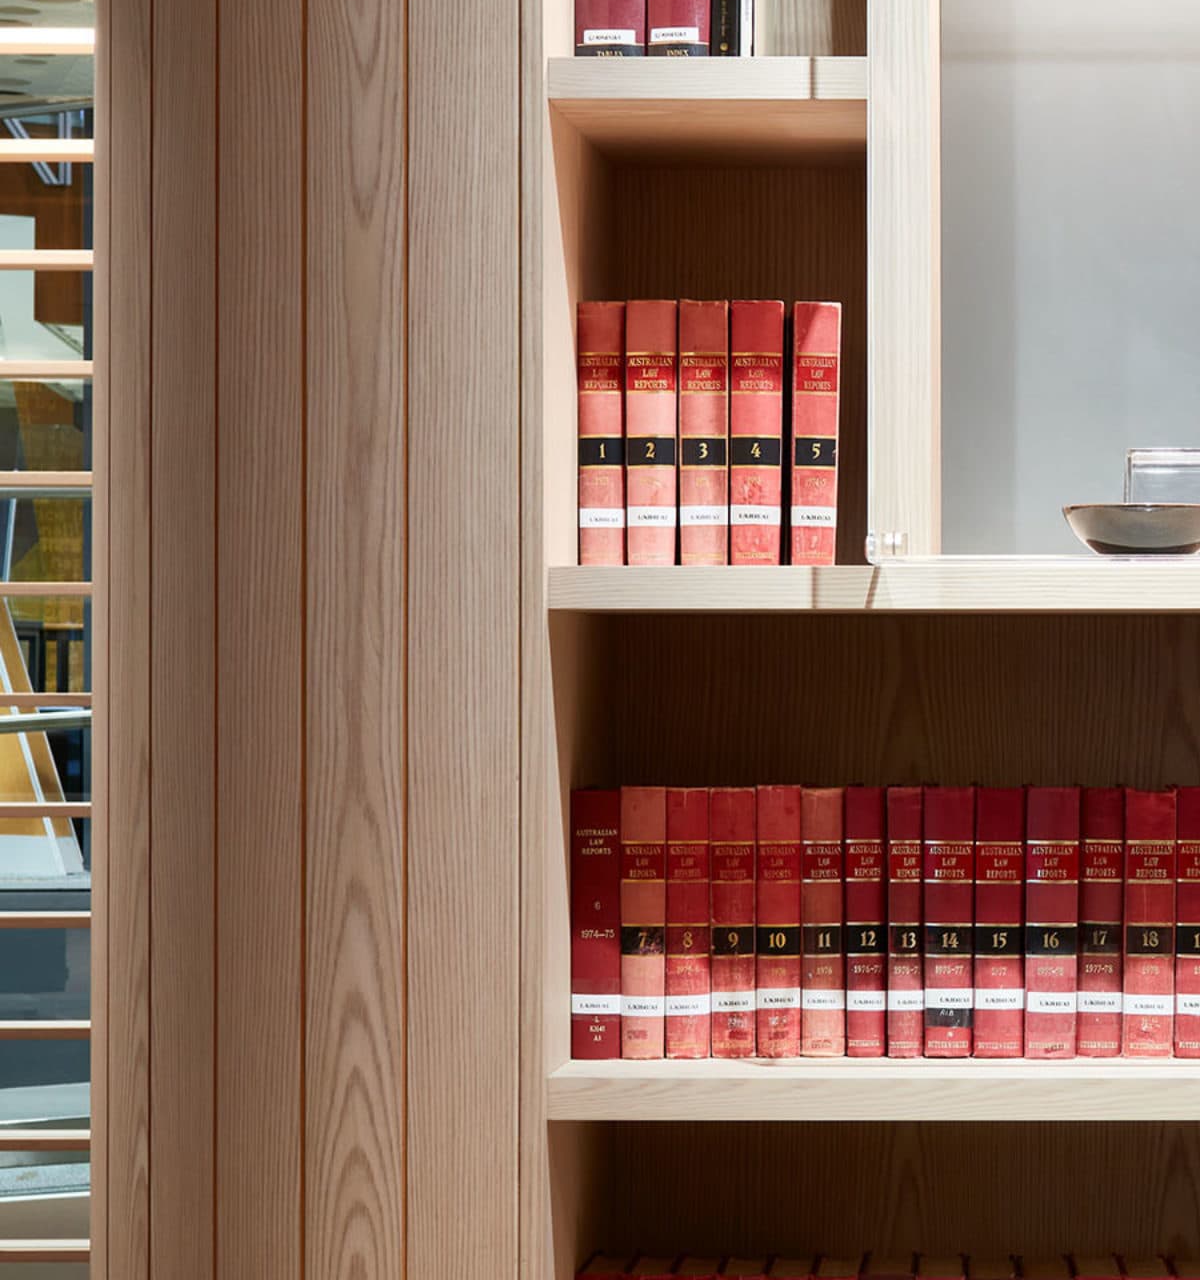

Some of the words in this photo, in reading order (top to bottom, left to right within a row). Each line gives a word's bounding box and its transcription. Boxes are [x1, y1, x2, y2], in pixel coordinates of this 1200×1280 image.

[598, 442, 607, 460] 1
[644, 441, 656, 460] 2
[698, 441, 709, 460] 3
[749, 441, 762, 459] 4
[811, 441, 822, 460] 5
[681, 930, 695, 951] 8
[726, 930, 740, 949] 9
[768, 931, 788, 950] 10
[817, 931, 832, 949] 11
[859, 929, 877, 948] 12
[901, 930, 918, 950] 13
[941, 931, 960, 950] 14
[992, 931, 1009, 950] 15
[1042, 930, 1061, 950] 16
[1092, 929, 1109, 947] 17
[1141, 929, 1160, 949] 18
